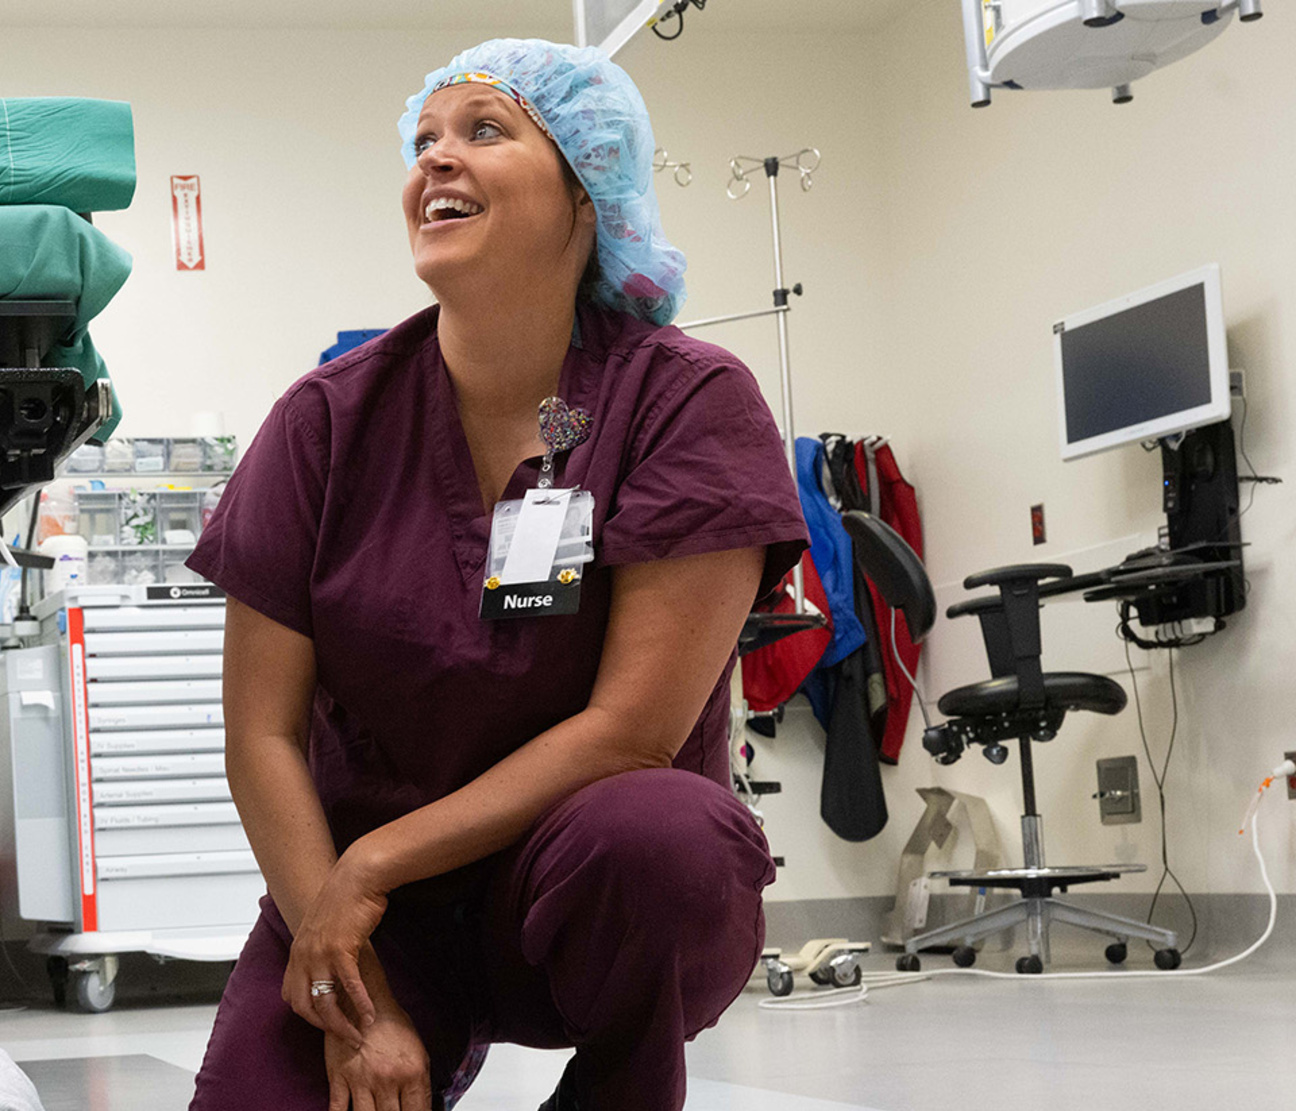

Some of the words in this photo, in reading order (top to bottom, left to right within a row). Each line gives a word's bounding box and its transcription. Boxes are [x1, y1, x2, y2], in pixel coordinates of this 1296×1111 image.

[174, 183, 195, 191] FIRE
[181, 588, 210, 596] Omnicell
[504, 594, 553, 609] Nurse
